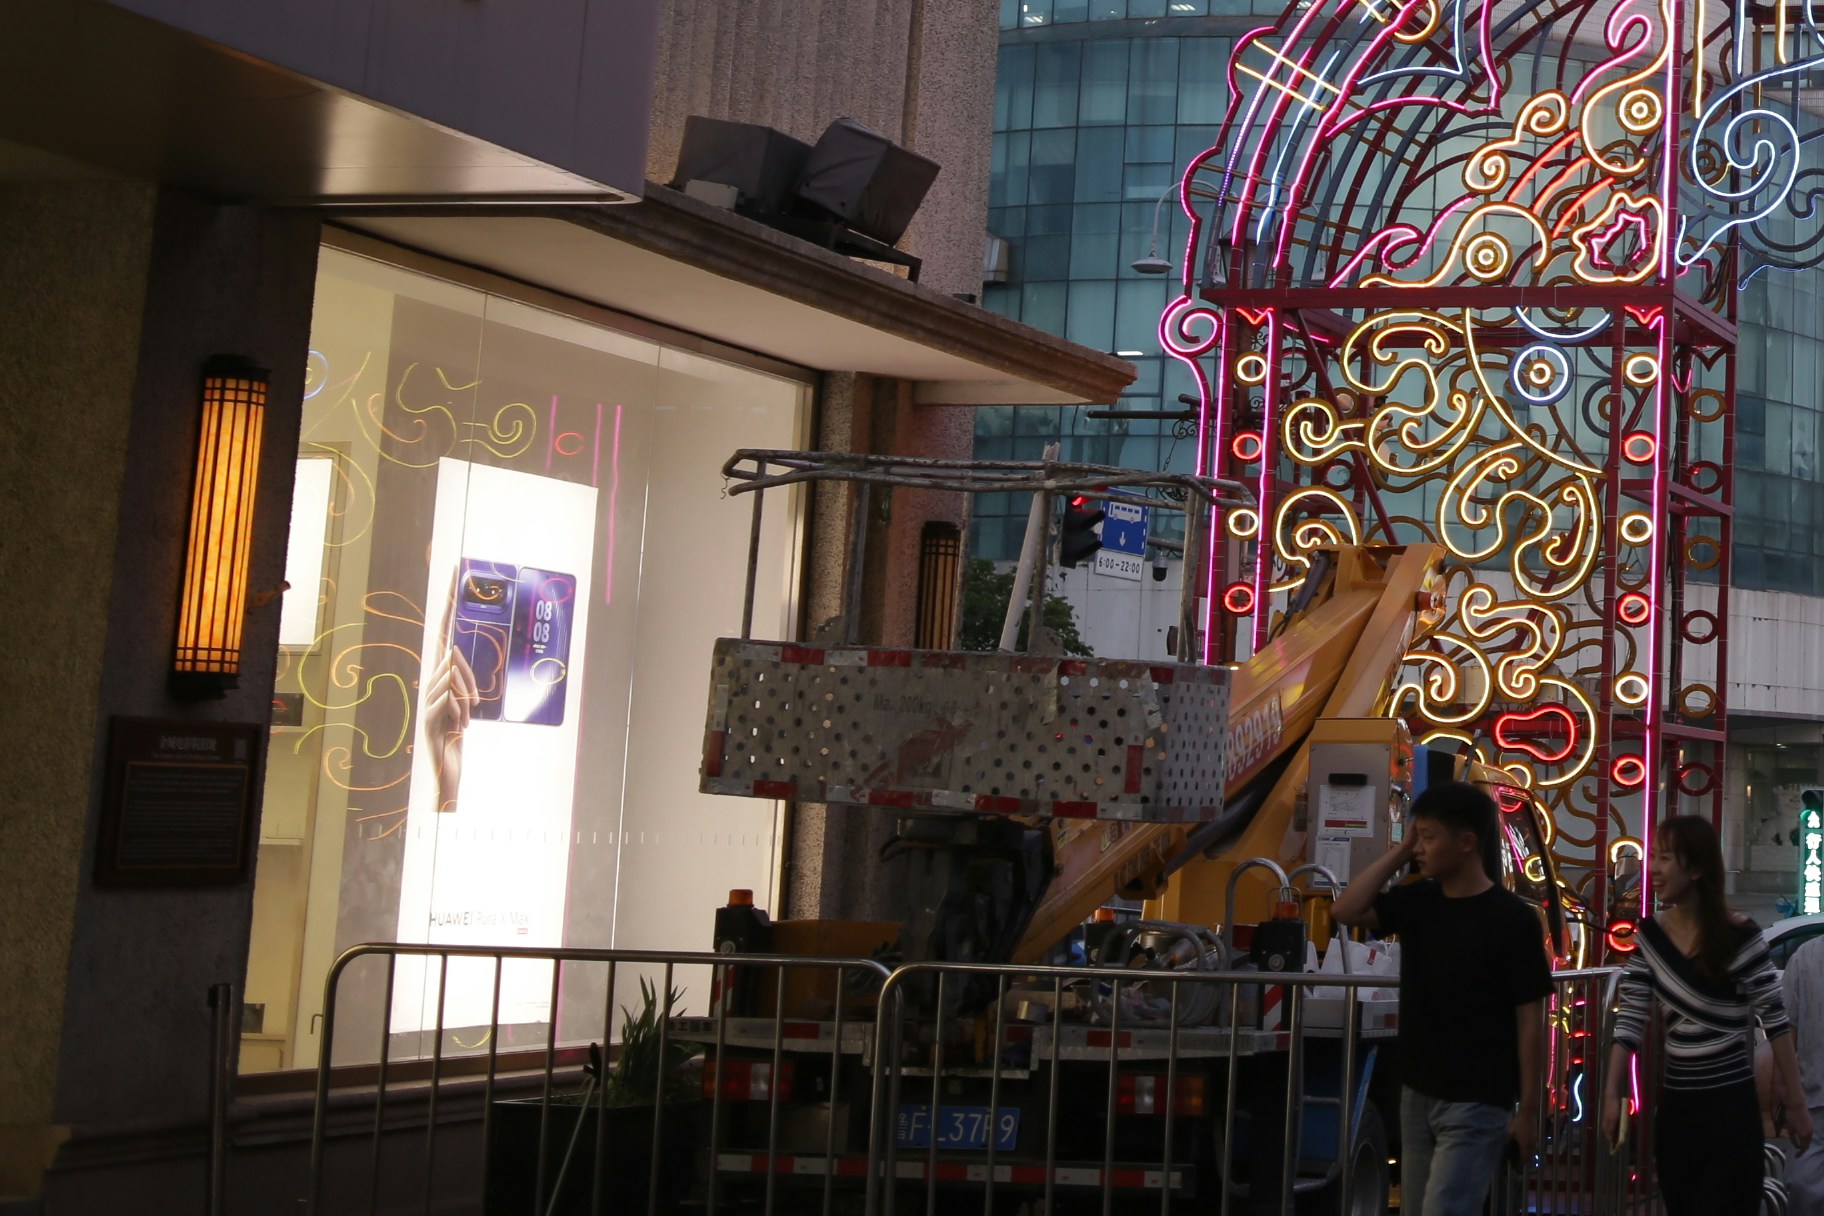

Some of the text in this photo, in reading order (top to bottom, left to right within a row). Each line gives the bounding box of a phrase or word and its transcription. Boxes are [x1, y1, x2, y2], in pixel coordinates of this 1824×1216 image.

[535, 599, 553, 621] 08
[533, 621, 550, 643] 08
[429, 911, 472, 927] HUAWEI
